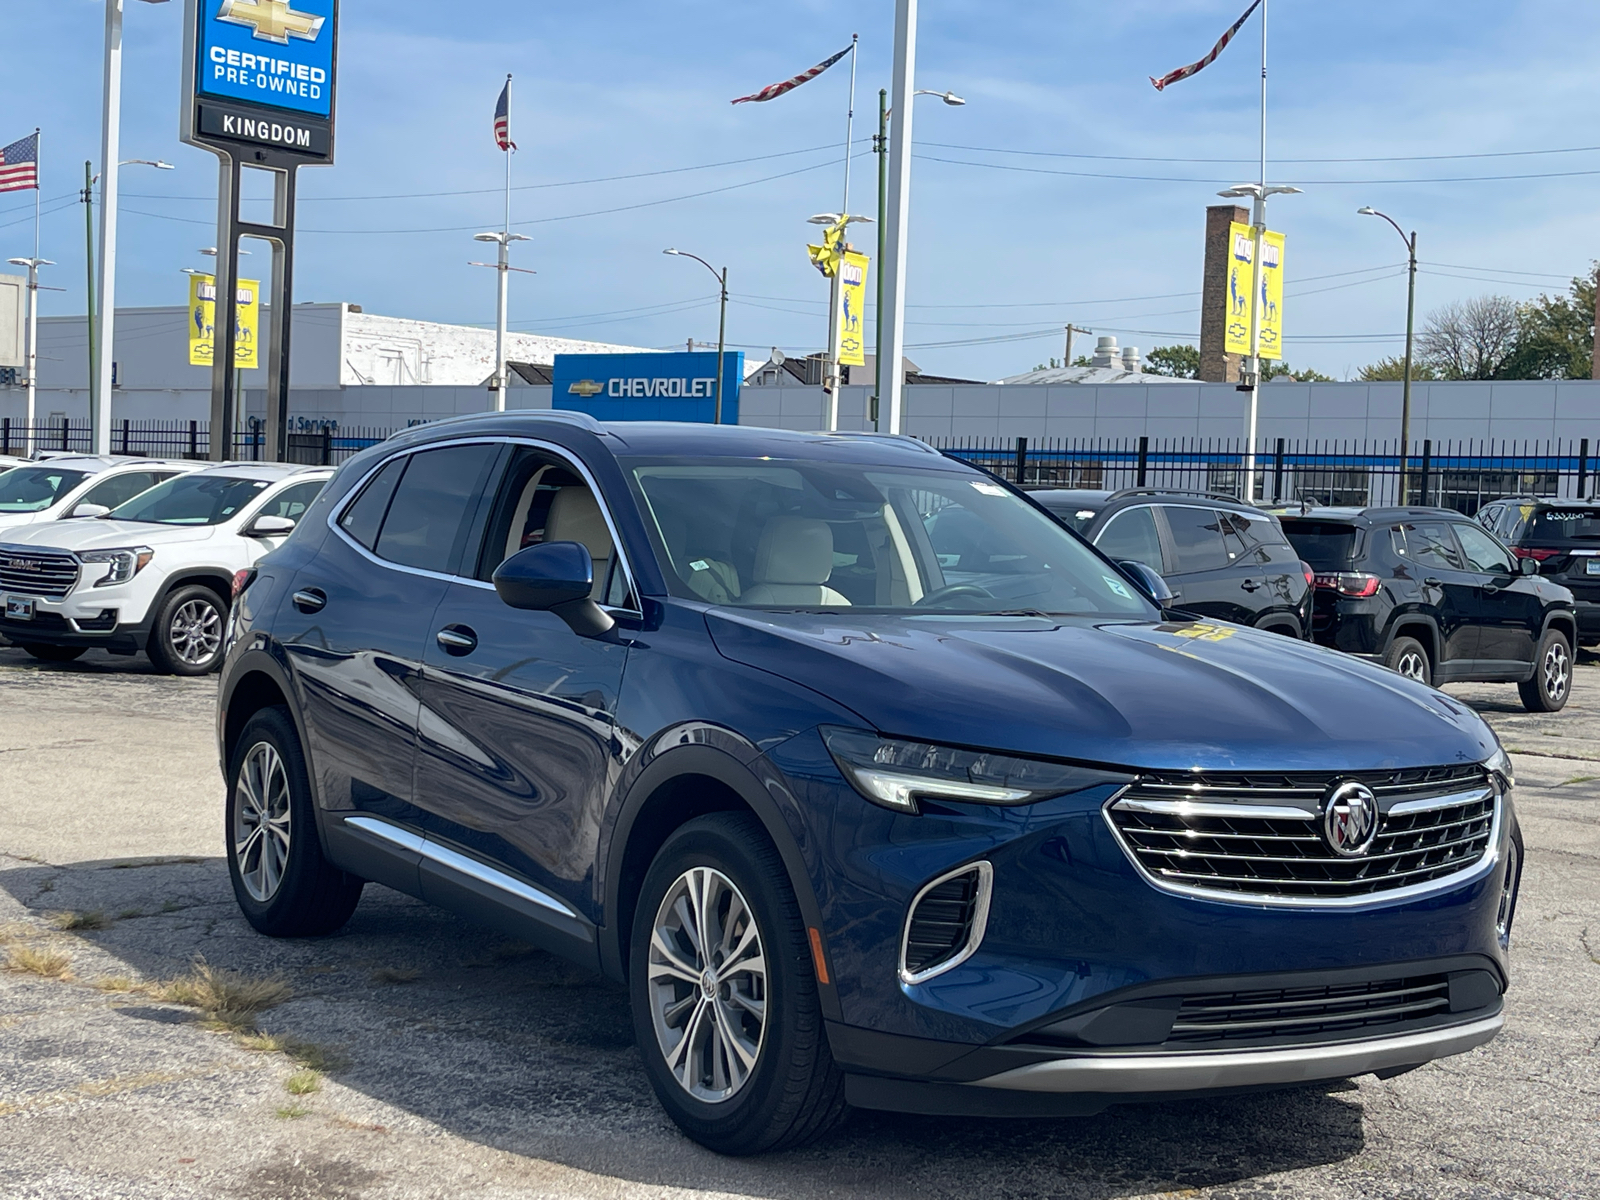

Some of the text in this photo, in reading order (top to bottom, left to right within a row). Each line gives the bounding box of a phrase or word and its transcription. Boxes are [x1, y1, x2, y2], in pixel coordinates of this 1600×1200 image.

[210, 46, 326, 84] CERTIFIED
[214, 65, 321, 100] PRE-OWNED
[223, 114, 311, 147] KINGDOM
[1234, 232, 1253, 264] King
[843, 263, 863, 286] dom
[608, 378, 717, 398] CHEVROLET
[8, 558, 41, 571] GMC
